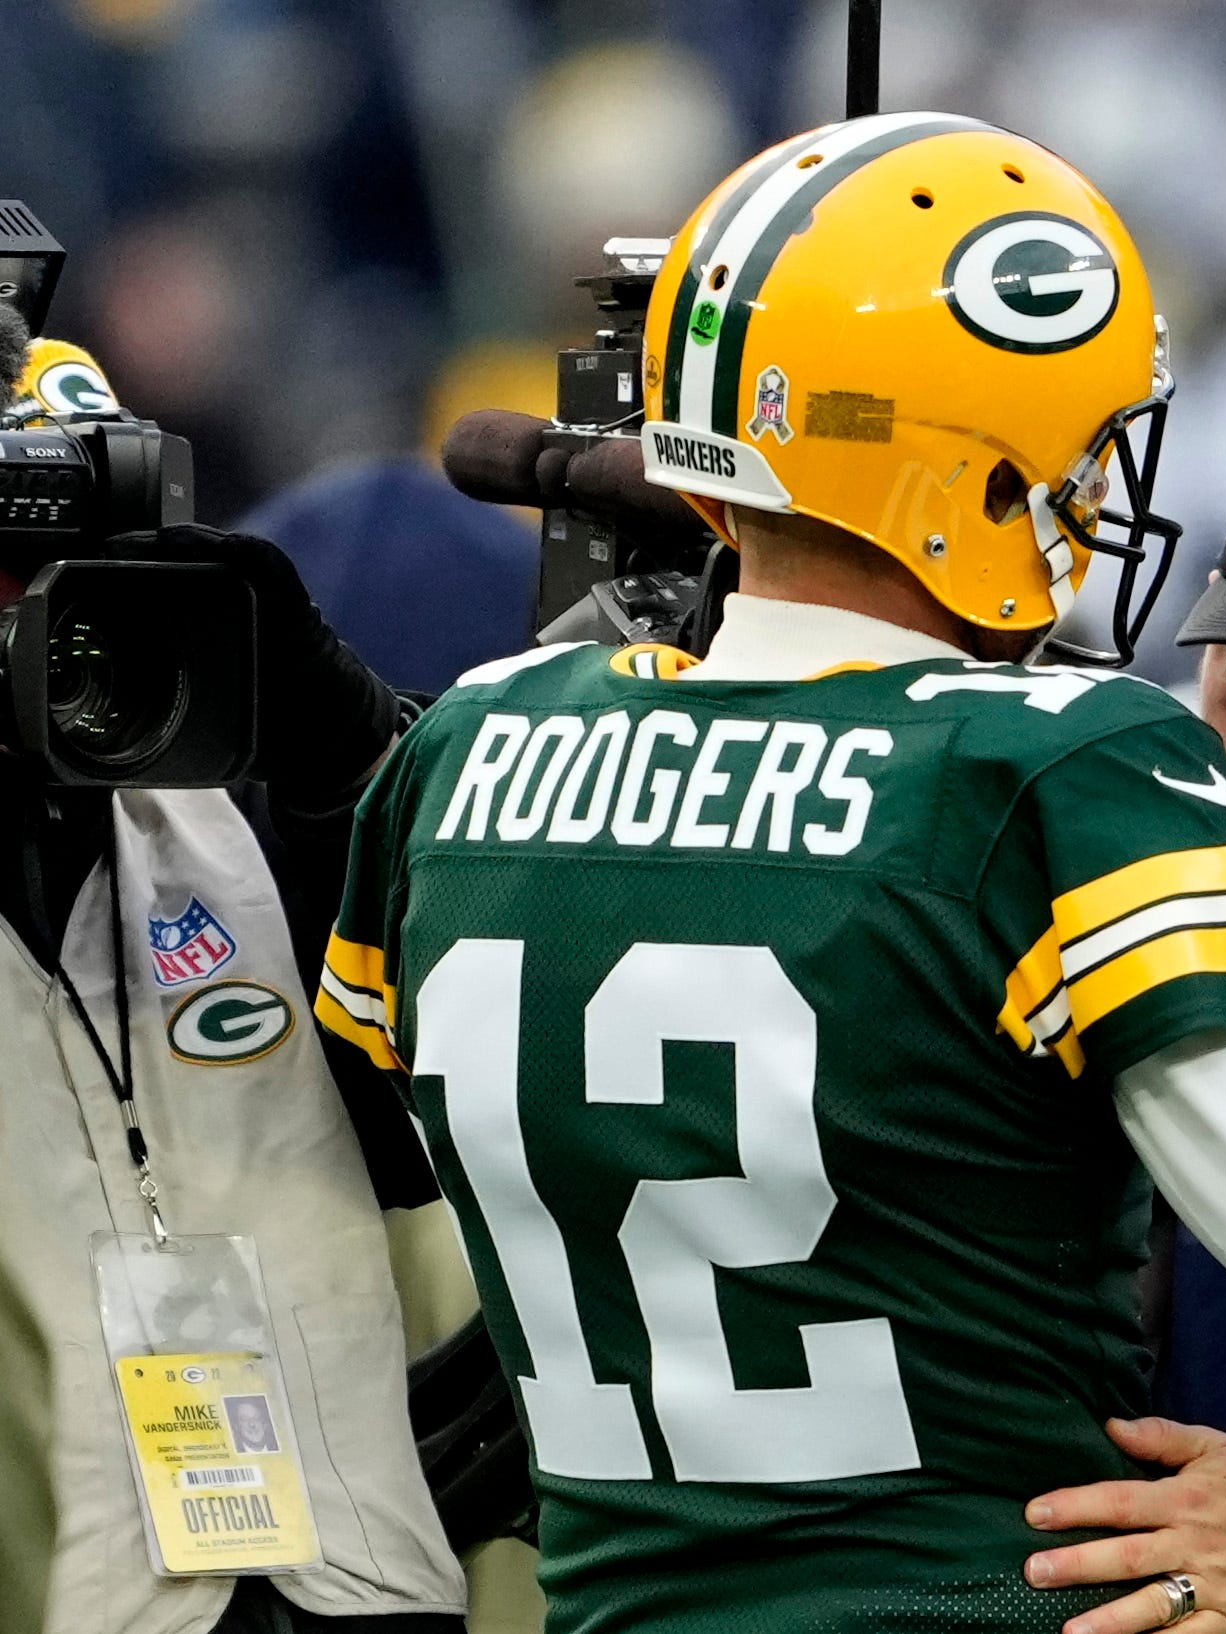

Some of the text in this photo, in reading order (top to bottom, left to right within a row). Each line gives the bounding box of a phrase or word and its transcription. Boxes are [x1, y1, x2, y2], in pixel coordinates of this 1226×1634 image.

[953, 219, 1117, 344] G
[39, 362, 117, 412] G
[760, 402, 781, 420] NFL
[25, 447, 66, 458] SONY
[653, 432, 737, 479] PACKERS
[435, 710, 893, 857] RODGERS
[151, 932, 231, 982] NFL
[172, 986, 286, 1057] G
[411, 938, 921, 1483] 12
[143, 1420, 222, 1434] VANDERSNICK
[174, 1404, 219, 1421] MIKE
[182, 1494, 279, 1533] OFFICIAL
